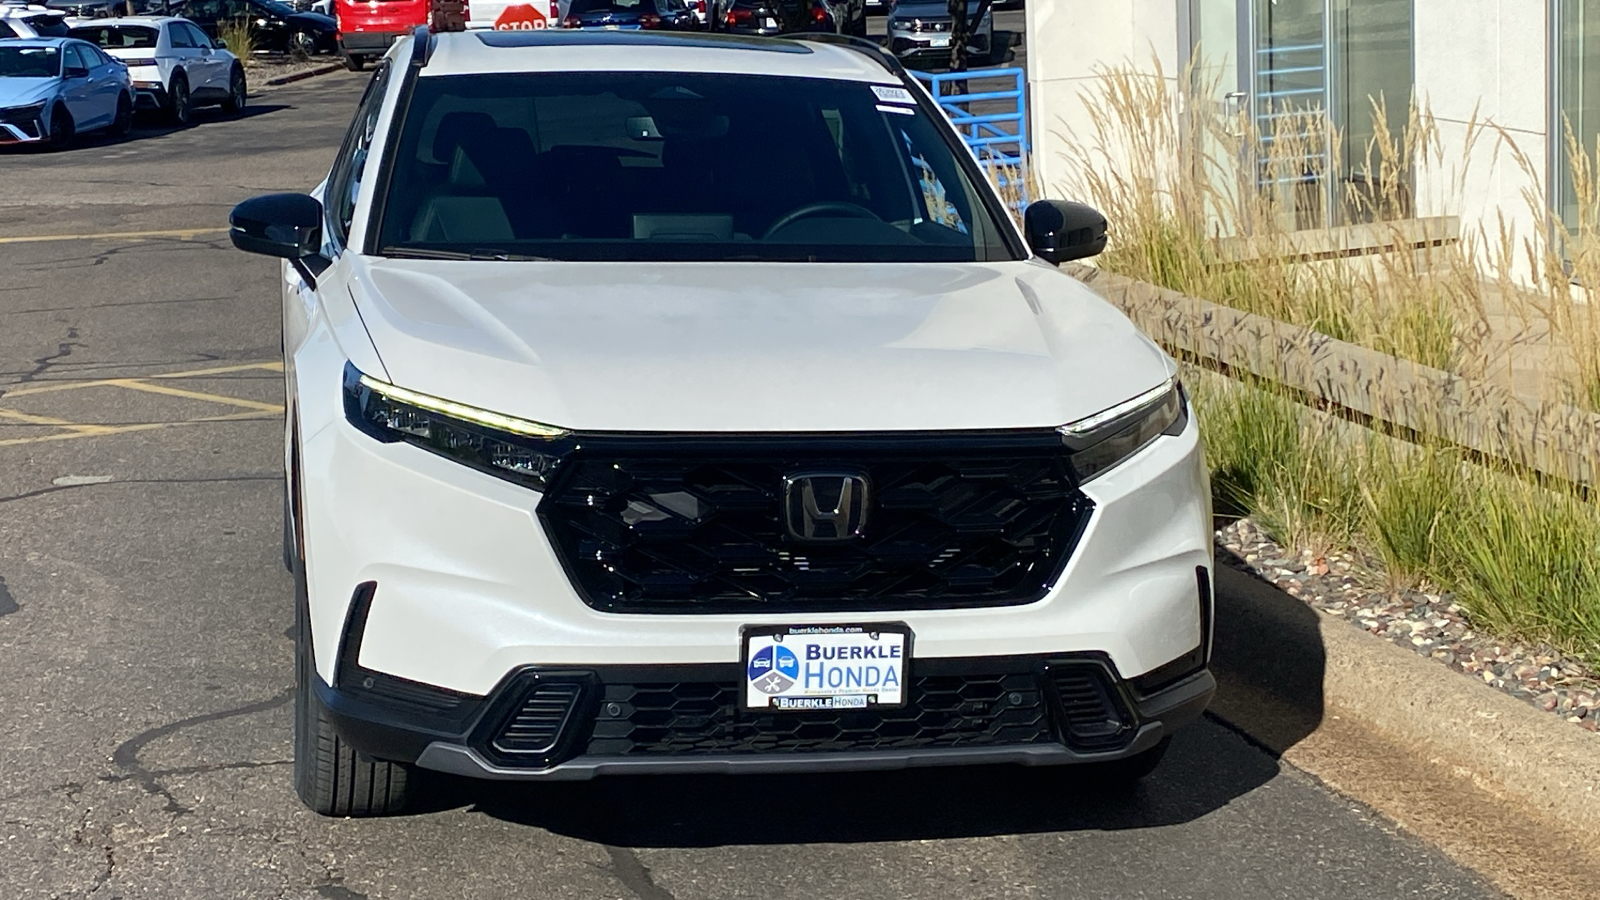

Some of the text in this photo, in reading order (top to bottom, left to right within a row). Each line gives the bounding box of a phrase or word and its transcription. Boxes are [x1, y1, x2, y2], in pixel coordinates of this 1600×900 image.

[788, 626, 863, 635] buerklehonda.com
[806, 643, 901, 660] BUERKLE
[804, 662, 899, 689] HONDA
[780, 696, 865, 708] BUERKLE HONDA
